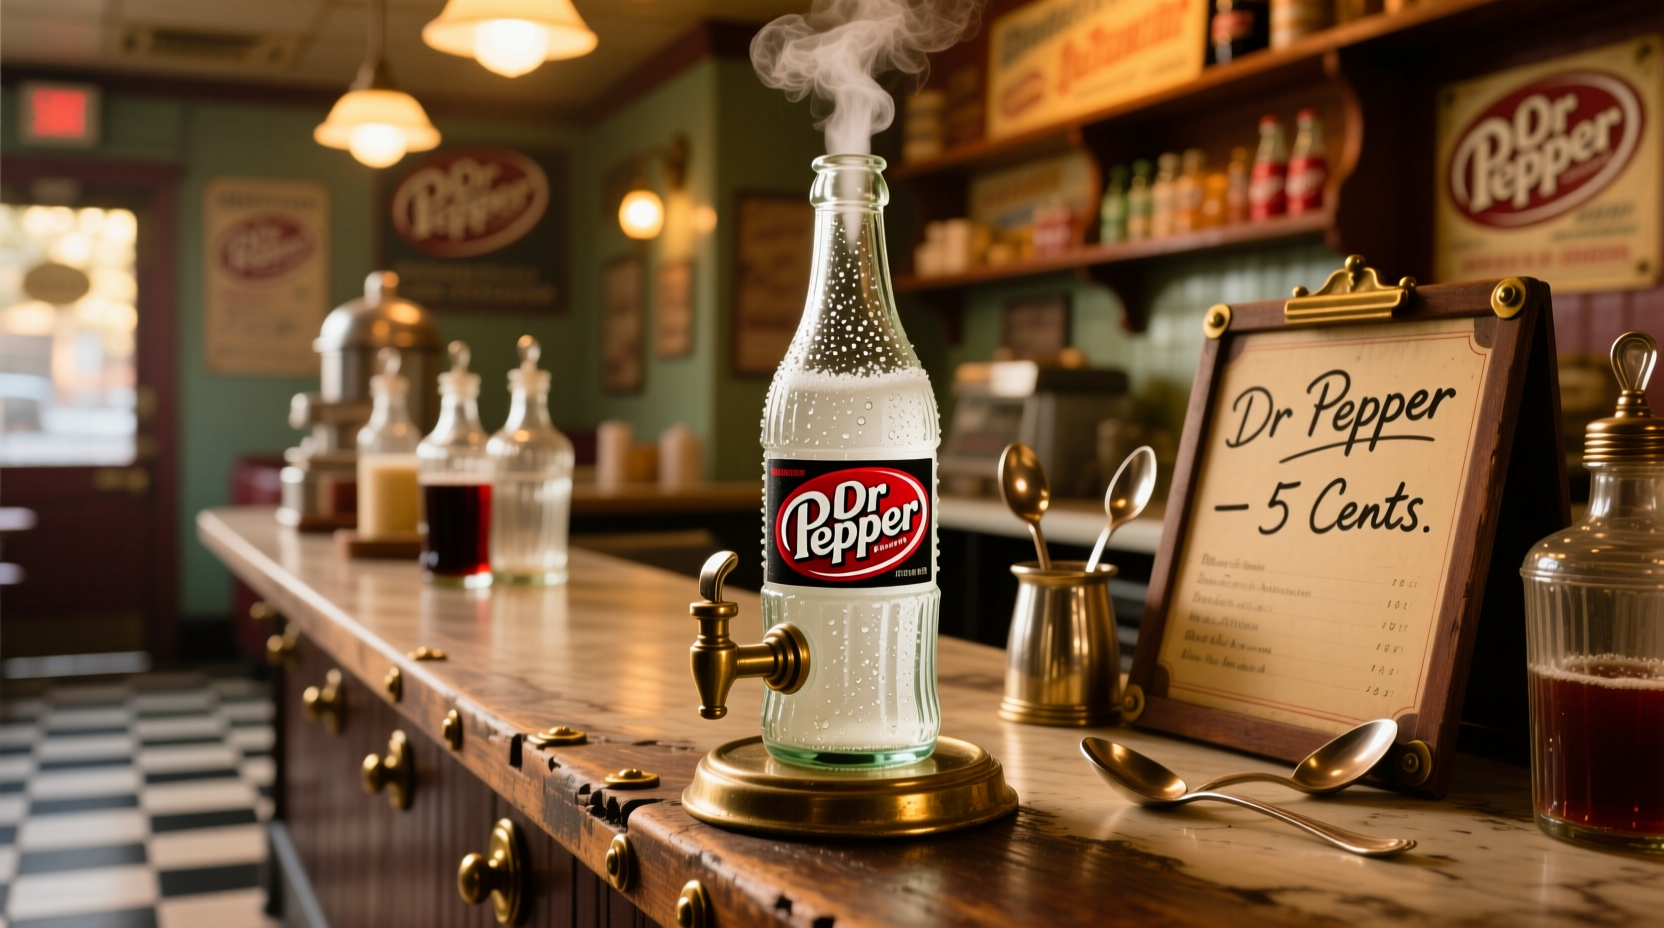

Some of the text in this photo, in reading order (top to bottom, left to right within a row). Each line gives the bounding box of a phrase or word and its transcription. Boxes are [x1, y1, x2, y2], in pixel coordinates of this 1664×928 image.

[1513, 92, 1578, 149] Dr
[1453, 106, 1622, 214] Pepper
[1225, 369, 1457, 457] Dr Pepper
[781, 490, 919, 565] Pepper
[833, 480, 887, 521] Dr
[1258, 481, 1302, 536] 5
[1309, 477, 1431, 535] Cents.
